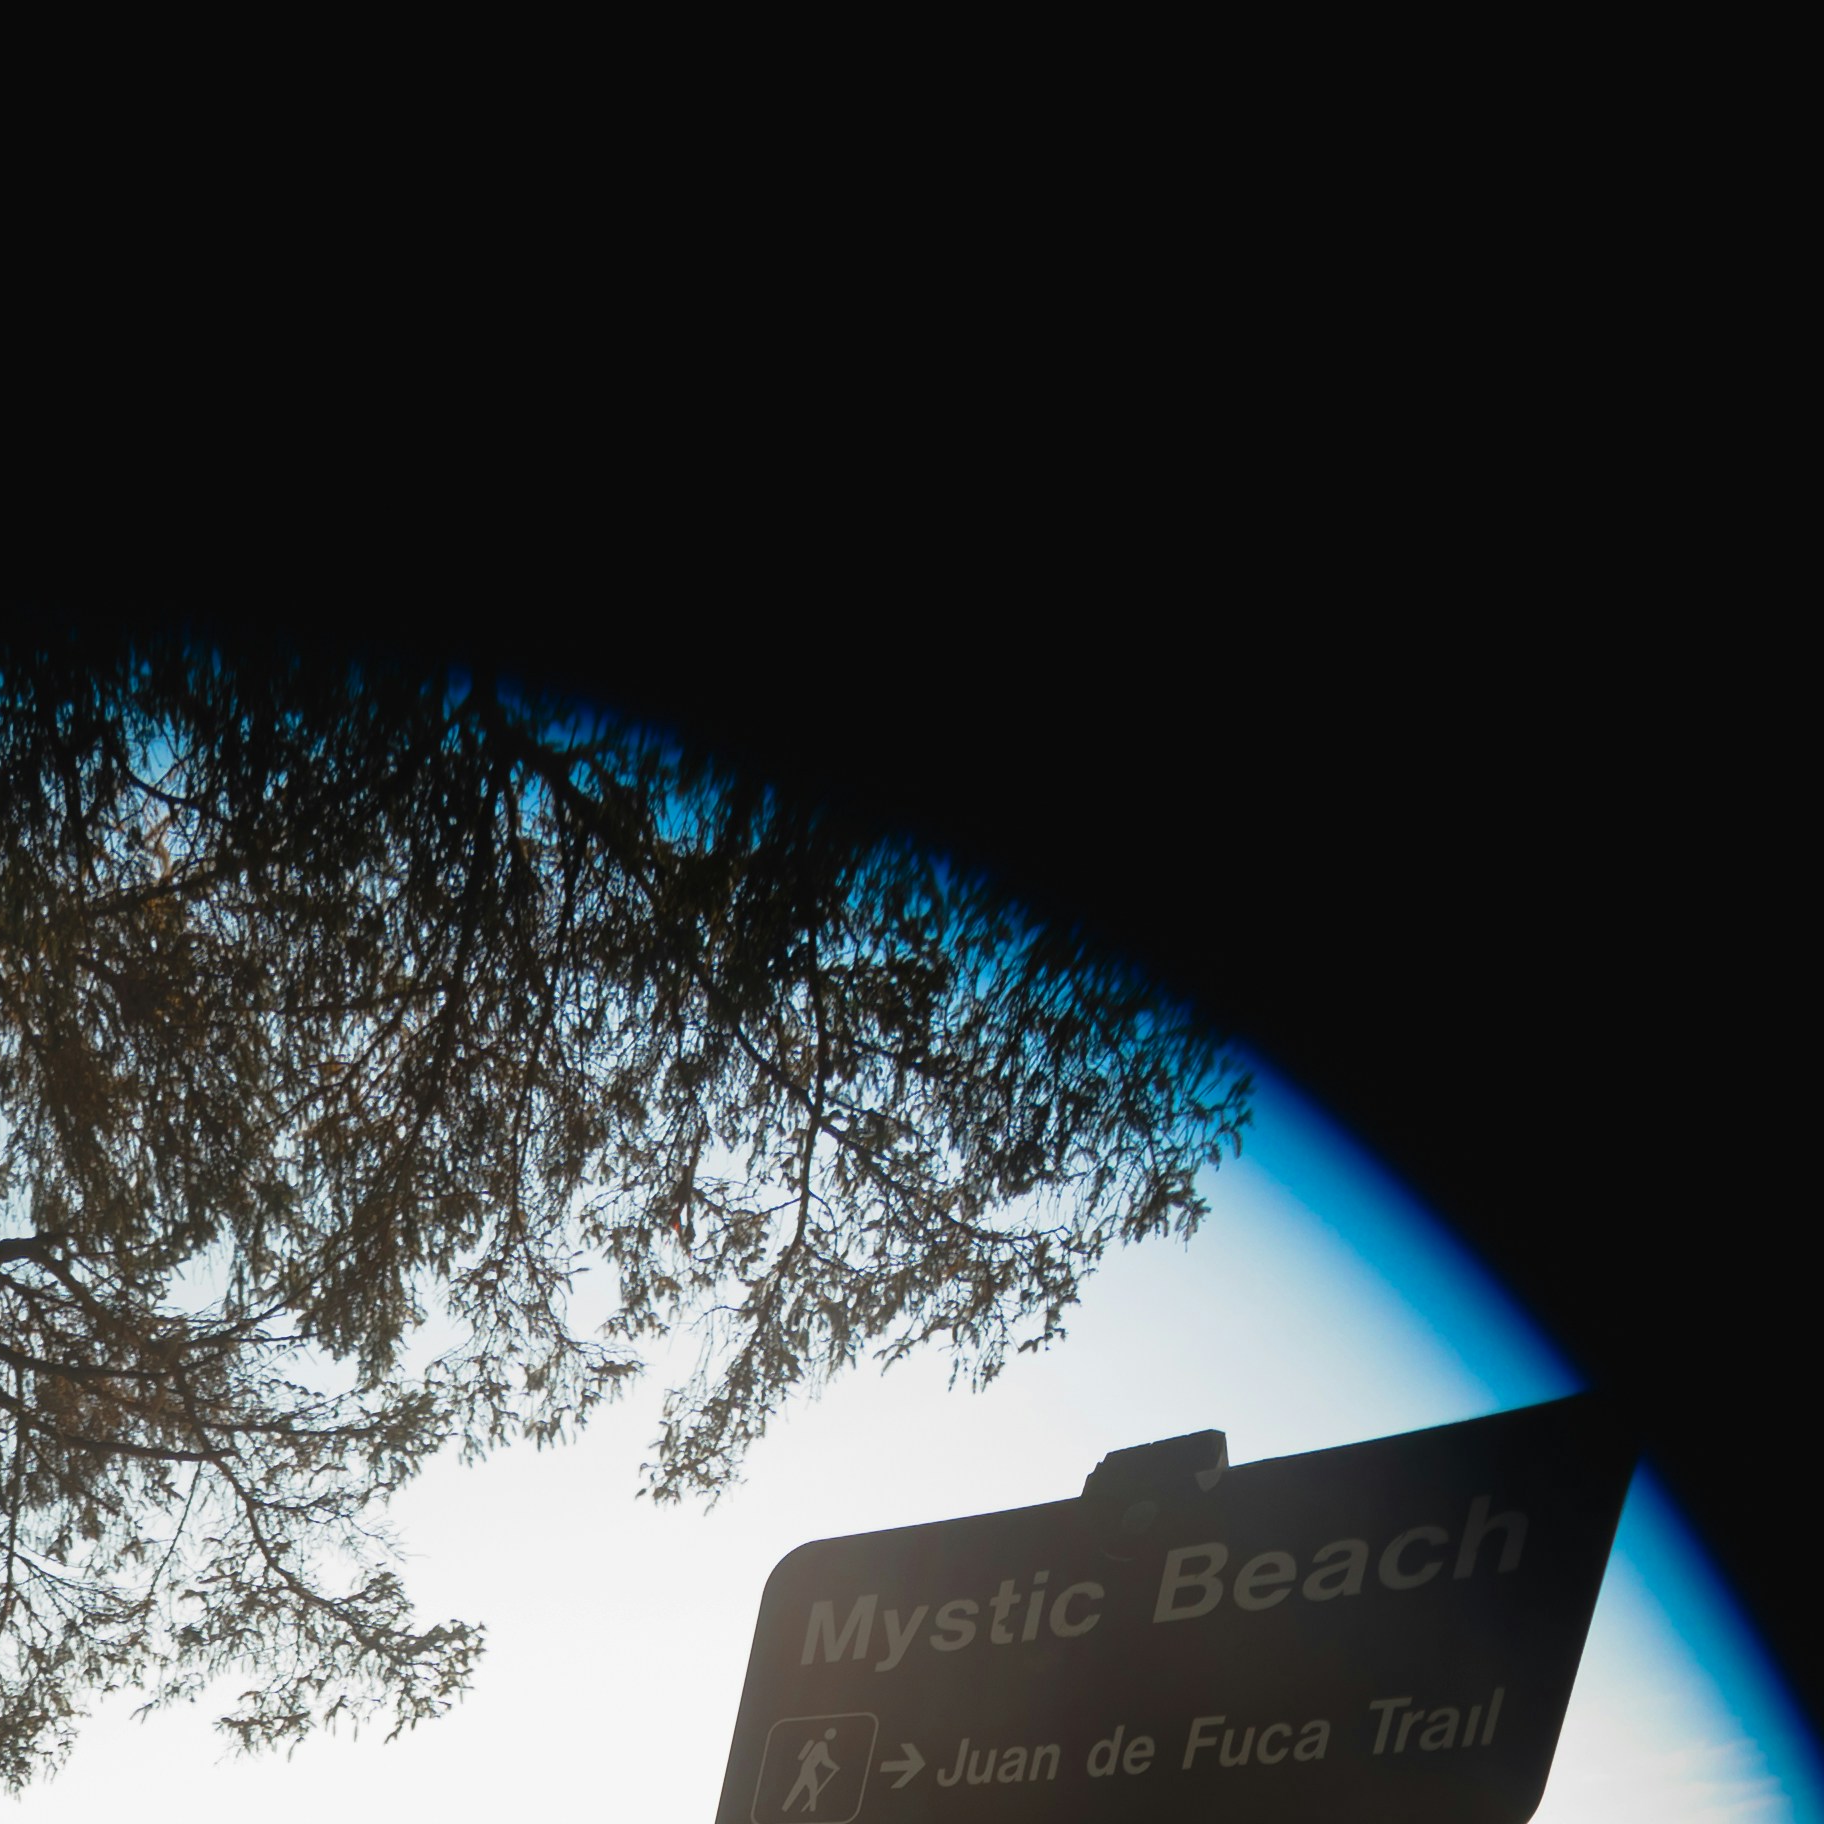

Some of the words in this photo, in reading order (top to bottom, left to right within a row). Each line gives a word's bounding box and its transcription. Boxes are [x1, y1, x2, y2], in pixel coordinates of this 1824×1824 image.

[800, 1569, 1104, 1671] Mystic
[1153, 1496, 1530, 1624] Beach
[936, 1736, 1060, 1789] Juan
[1086, 1725, 1155, 1779] de
[1182, 1713, 1330, 1771] Fuca
[1369, 1688, 1505, 1754] Trail
